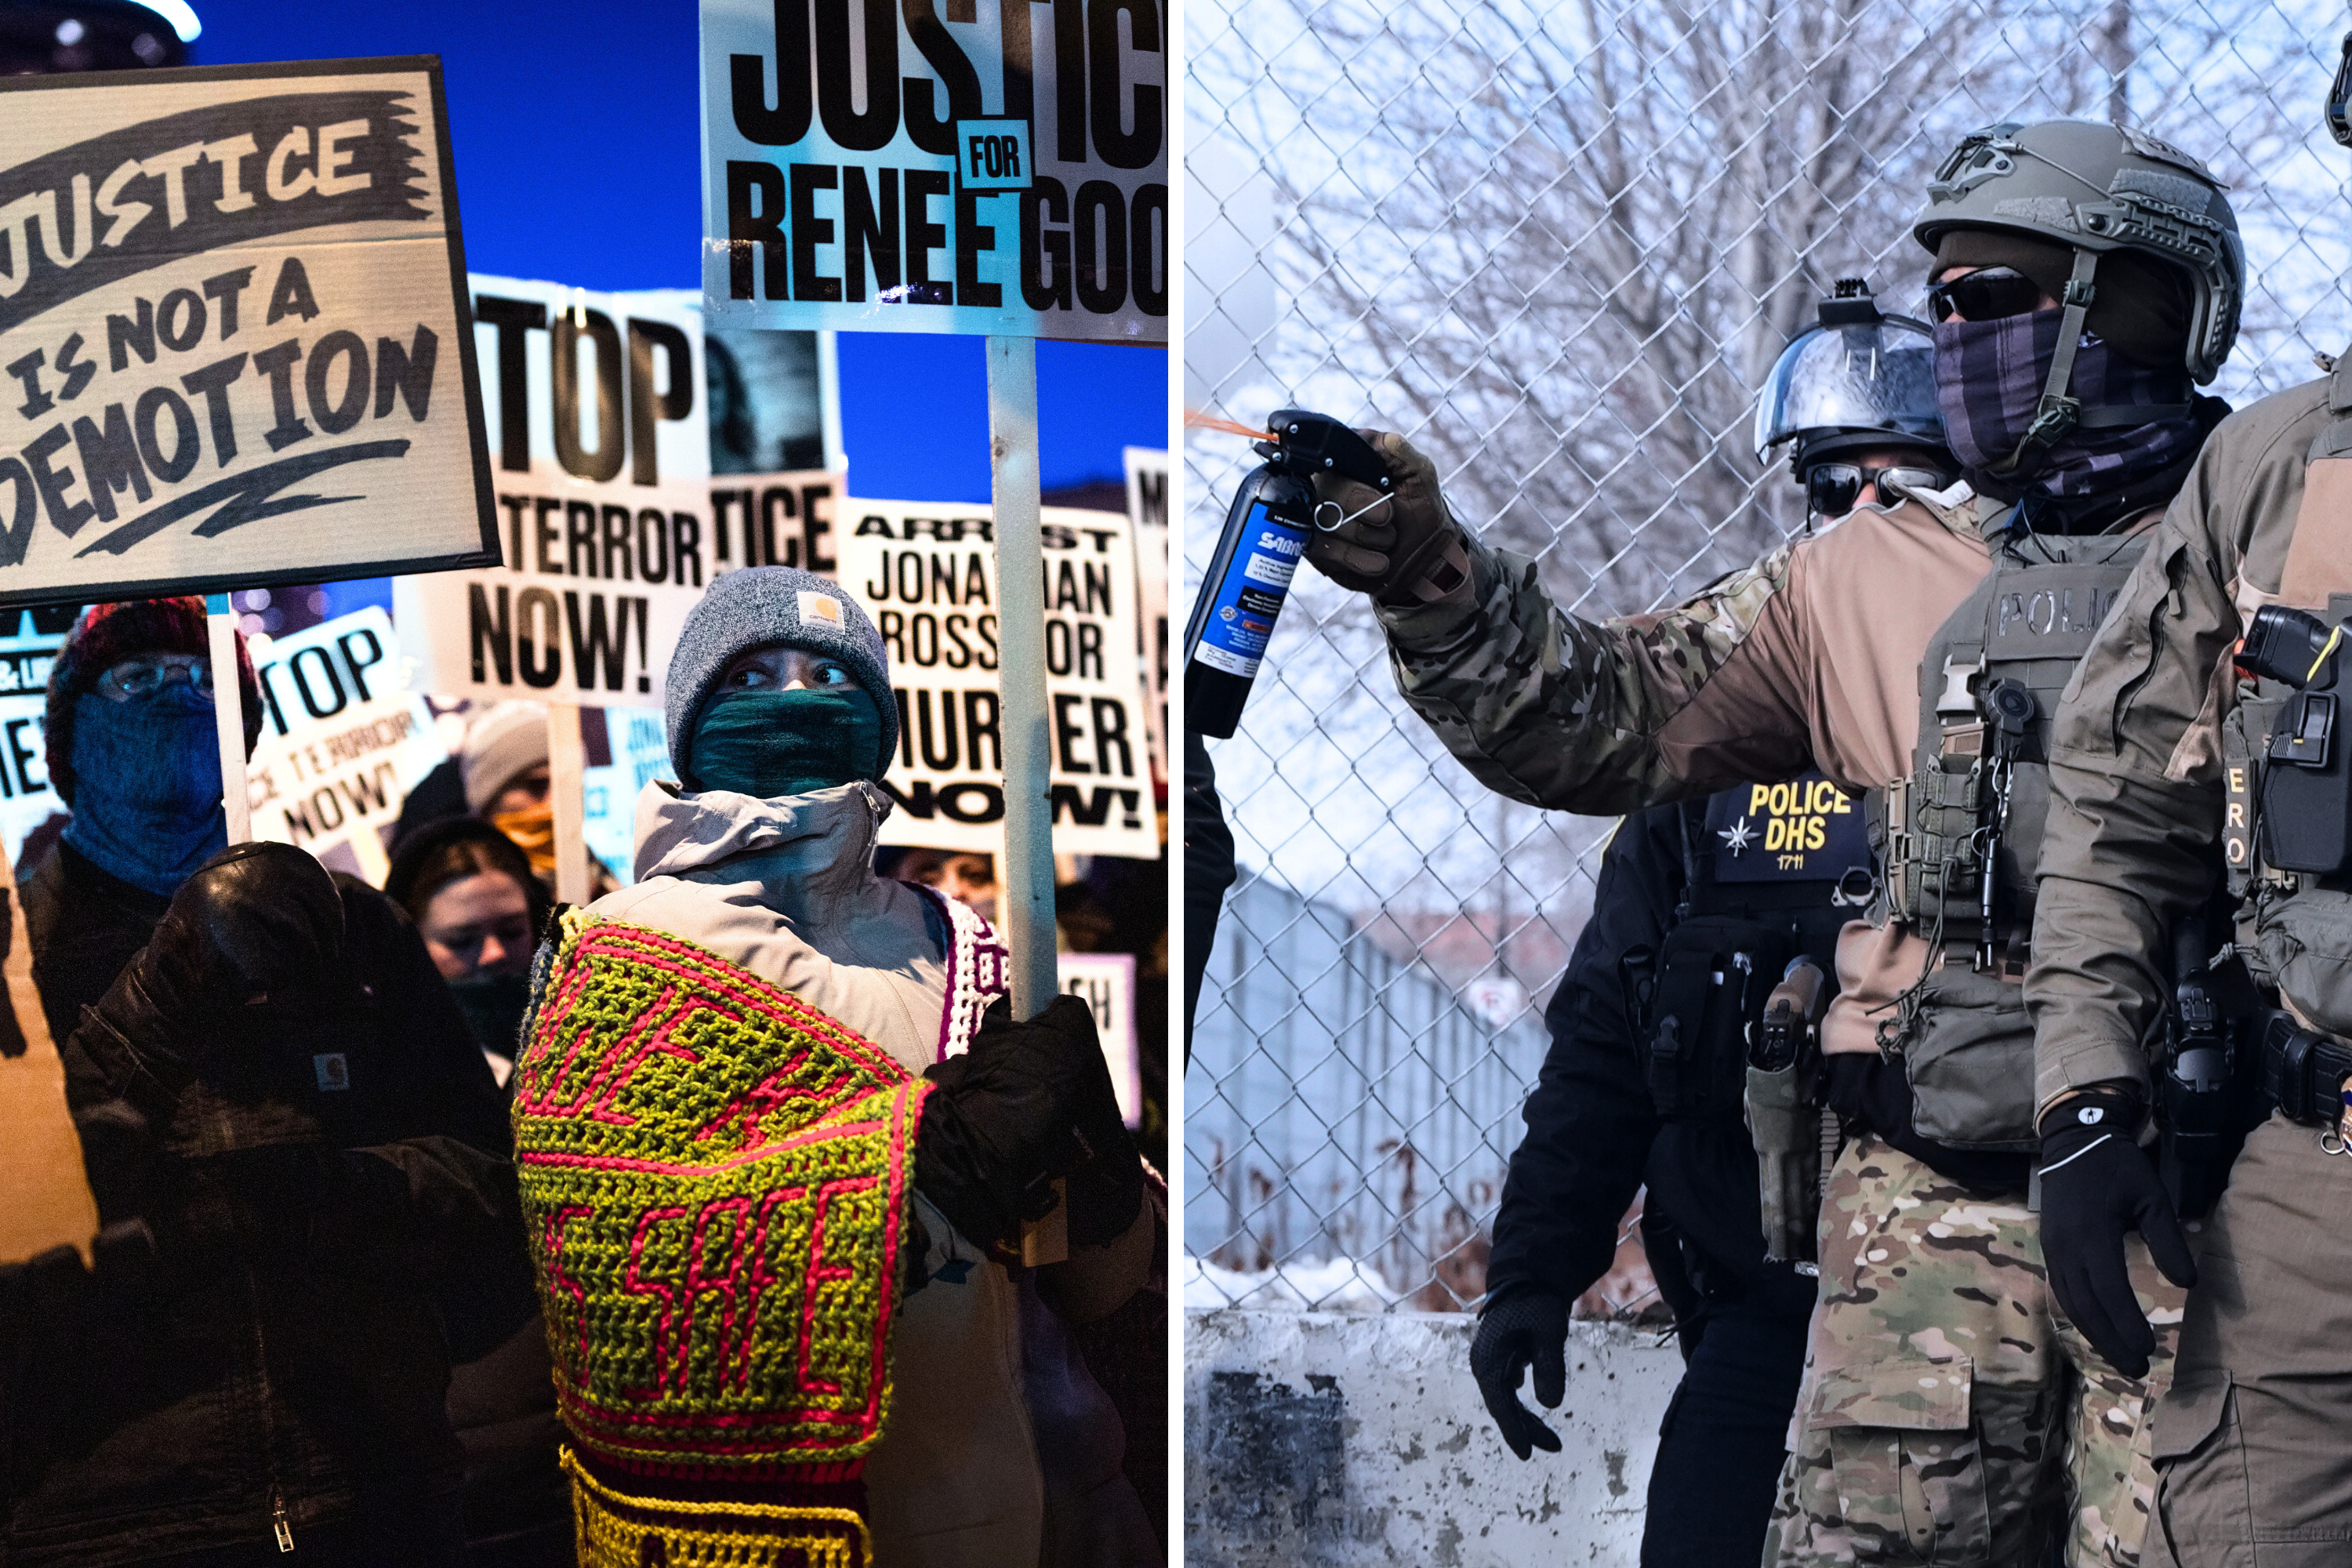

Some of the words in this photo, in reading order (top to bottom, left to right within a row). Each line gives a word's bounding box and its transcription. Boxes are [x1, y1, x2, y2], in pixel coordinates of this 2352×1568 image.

[729, 0, 1168, 170] JUSTIC
[968, 134, 1021, 179] FOR
[0, 118, 372, 299] JUSTICE
[726, 159, 1003, 308] RENEE
[6, 332, 97, 420] IS
[107, 265, 257, 372] NOT
[267, 256, 321, 326] A
[0, 323, 439, 567] DEMOTION
[499, 495, 703, 588] TERROR
[854, 514, 1120, 554] ARRST
[866, 550, 1113, 617] JONAAN
[470, 581, 651, 694] NOW!
[880, 610, 998, 670] ROSS
[1046, 618, 1105, 681] OR
[898, 688, 1134, 778] URER
[878, 779, 1142, 829] NOW!
[1748, 780, 1852, 817] POLICE
[1764, 815, 1826, 851] DHS
[2227, 768, 2245, 864] ERO
